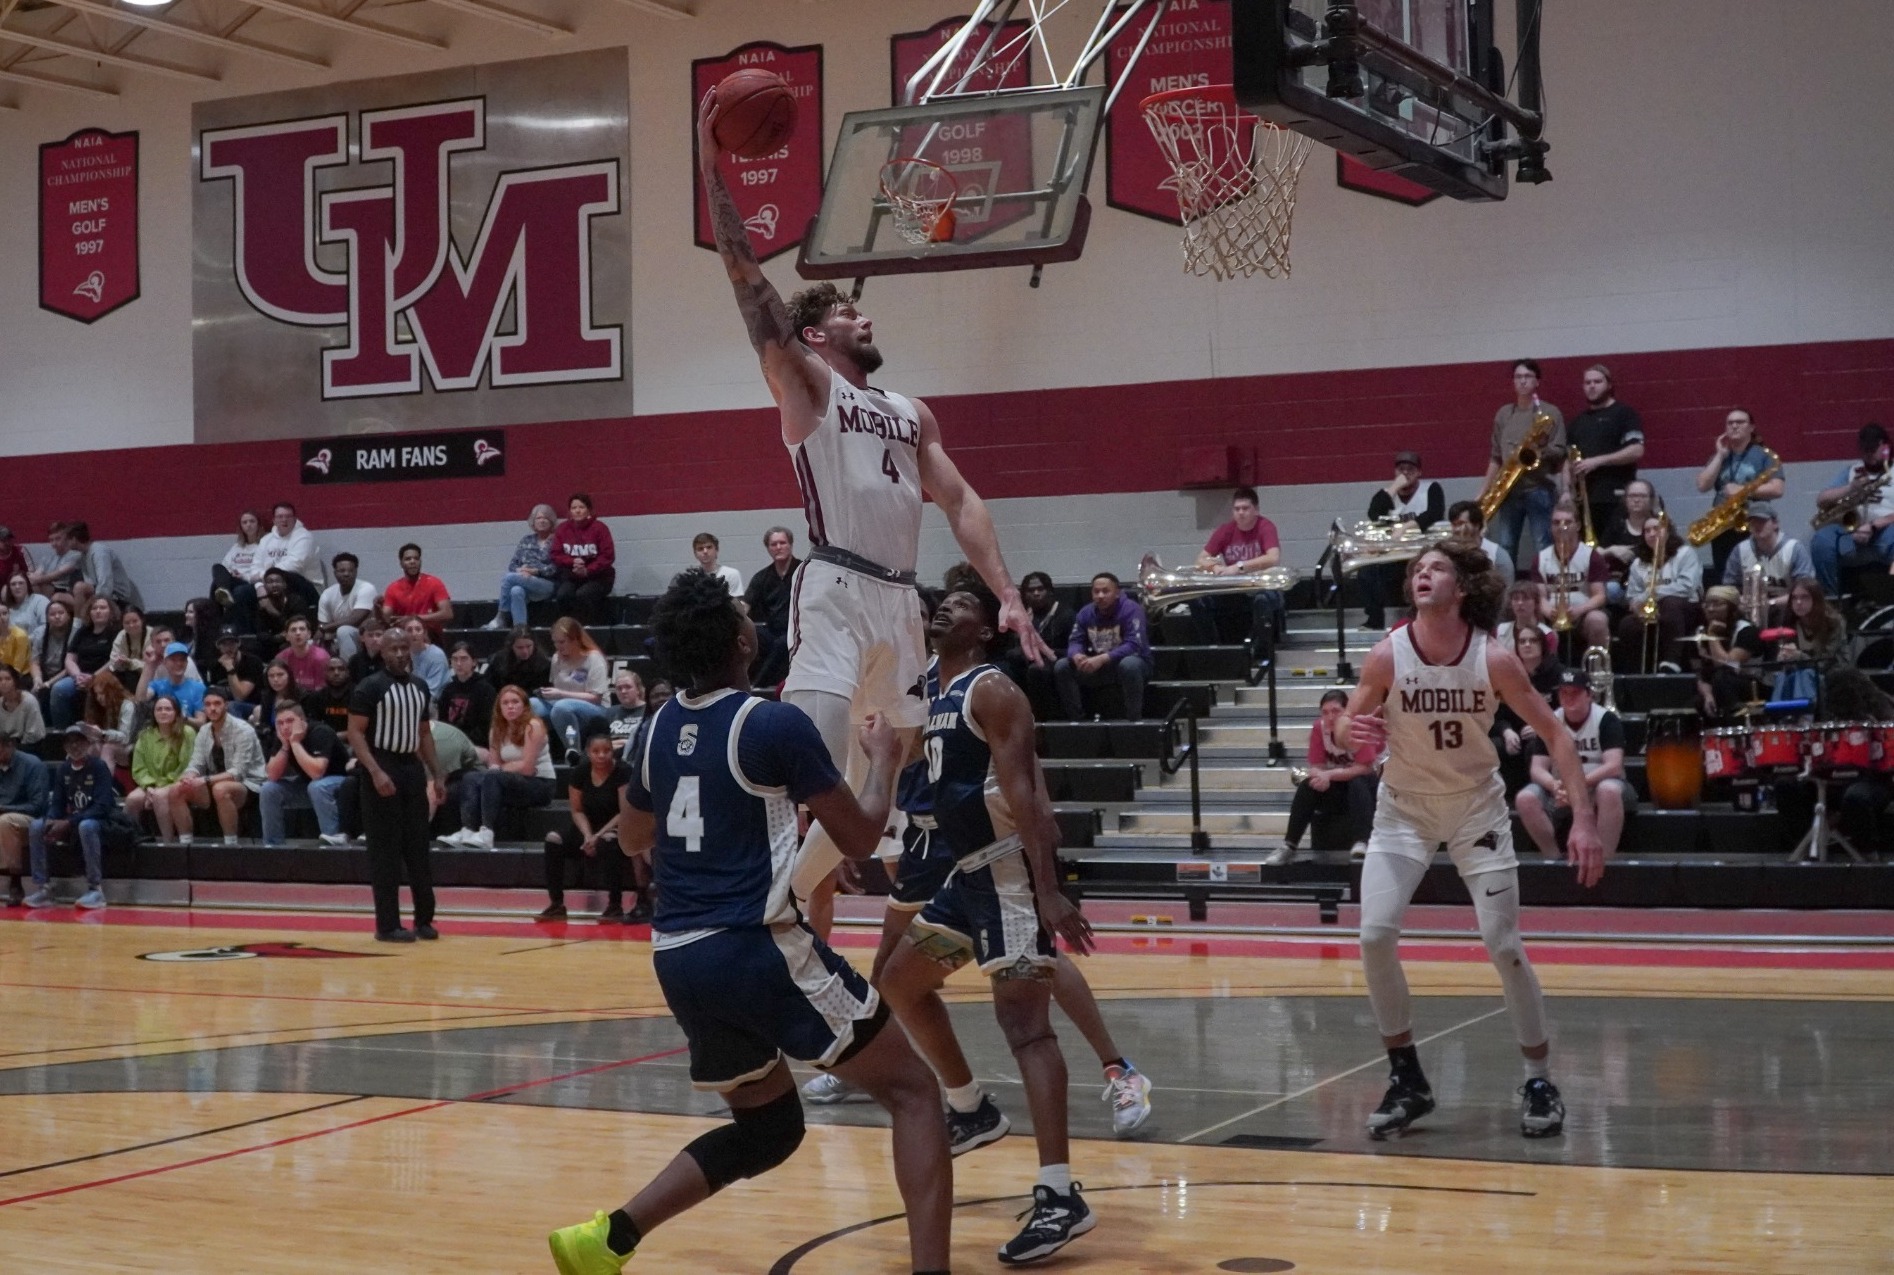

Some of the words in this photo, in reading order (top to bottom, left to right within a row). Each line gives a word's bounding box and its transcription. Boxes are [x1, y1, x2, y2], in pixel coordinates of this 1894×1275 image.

[739, 51, 776, 65] NAIA
[1150, 73, 1209, 93] MEN'S
[938, 122, 986, 141] GOLF
[74, 136, 103, 148] NAIA
[61, 153, 117, 170] NATIONAL
[942, 147, 983, 165] 1998
[47, 166, 132, 187] CHAMPIONSHIP
[740, 168, 778, 186] 1997
[69, 197, 109, 215] MEN'S
[72, 218, 107, 235] GOLF
[75, 239, 104, 255] 1997
[837, 404, 918, 448] MOBILE
[356, 448, 395, 470] RAM
[401, 445, 448, 468] FANS
[882, 449, 900, 483] 4
[1400, 688, 1486, 713] MOBILE
[1428, 720, 1463, 750] 13
[666, 776, 704, 852] 4
